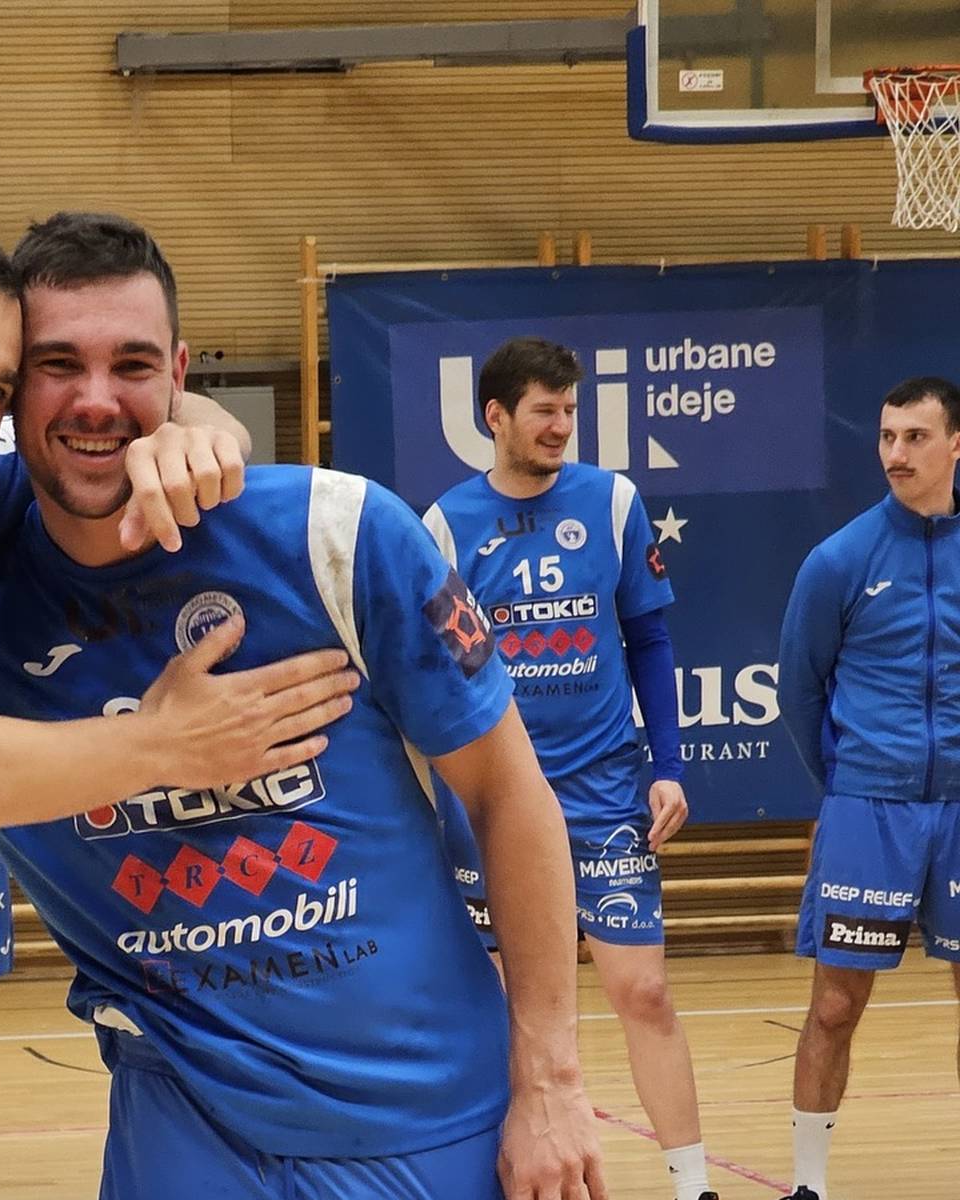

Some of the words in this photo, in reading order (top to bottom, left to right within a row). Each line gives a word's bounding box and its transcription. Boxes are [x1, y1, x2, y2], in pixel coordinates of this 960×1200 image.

[645, 338, 776, 373] urbane
[646, 382, 736, 422] ideje
[513, 555, 565, 595] 15
[514, 595, 595, 621] TOKIĆ
[504, 655, 598, 679] utomobili
[631, 663, 781, 728] us
[643, 741, 770, 762] TURANT
[580, 854, 658, 878] MAVERICK
[821, 882, 859, 902] DEEP
[863, 889, 914, 907] RELIEF
[117, 877, 357, 955] automobili
[606, 916, 629, 929] ICT
[343, 939, 379, 965] LAB
